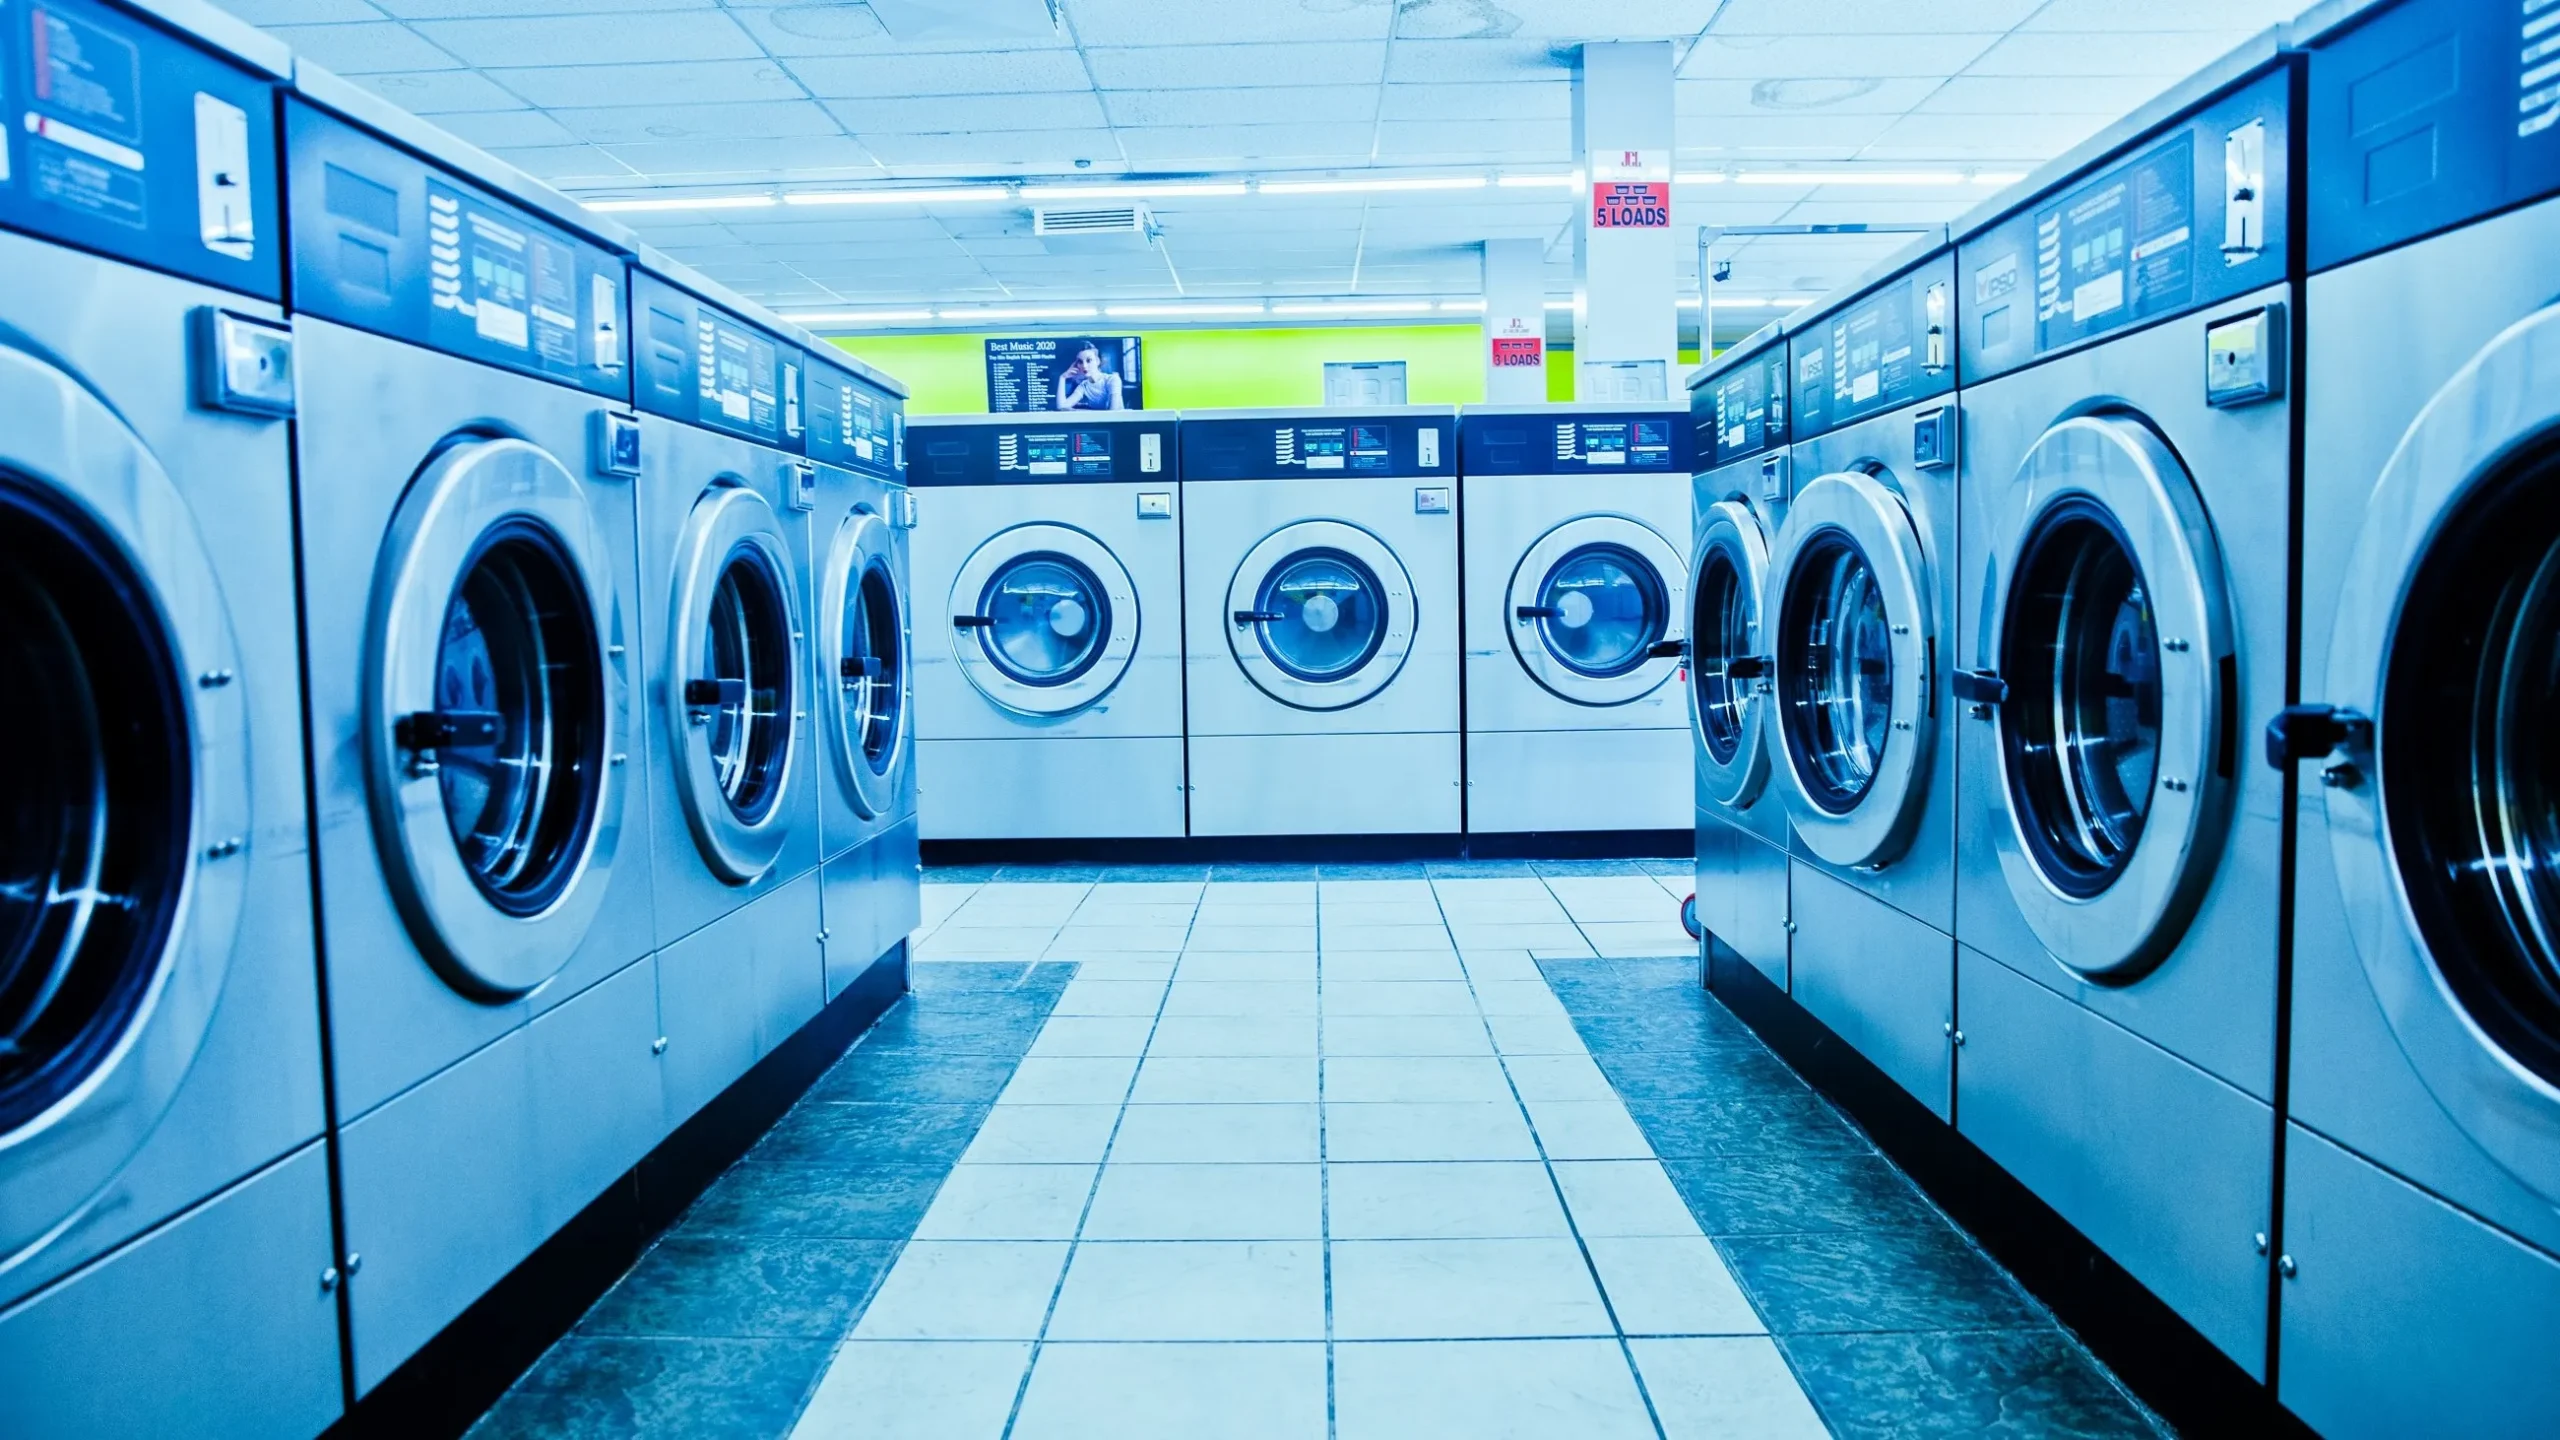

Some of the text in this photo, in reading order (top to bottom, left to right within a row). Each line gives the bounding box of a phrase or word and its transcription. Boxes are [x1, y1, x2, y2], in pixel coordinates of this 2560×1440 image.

[1597, 207, 1666, 226] 5 LOADS
[990, 341, 1056, 351] Best Music 2020
[1495, 354, 1540, 366] 3 LOADS
